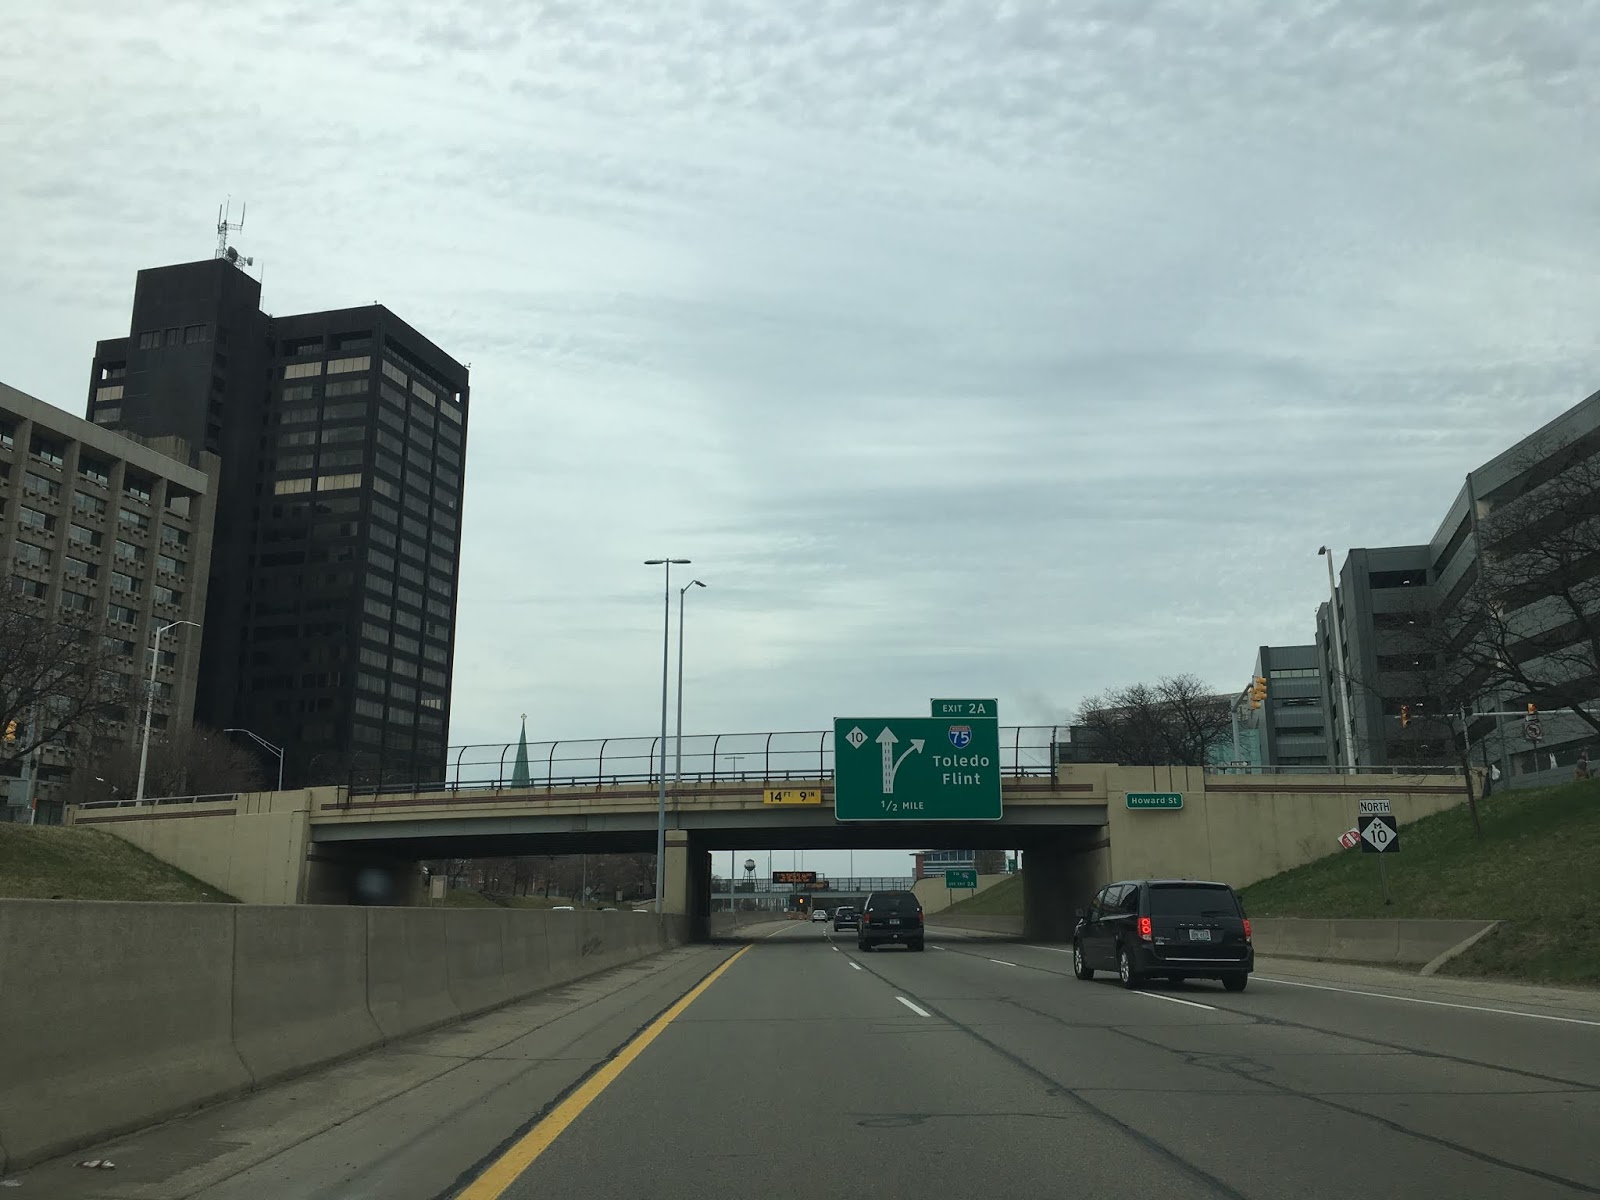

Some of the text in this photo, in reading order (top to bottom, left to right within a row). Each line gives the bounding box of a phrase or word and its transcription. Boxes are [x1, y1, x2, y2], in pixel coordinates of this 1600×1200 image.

[942, 703, 986, 714] EXIT 2A
[850, 732, 864, 743] 10
[950, 731, 970, 744] 75
[932, 754, 990, 767] Toledo
[942, 772, 981, 785] Flint
[880, 800, 925, 812] 1/2 MILE
[1360, 801, 1390, 812] NORTH
[1370, 829, 1388, 843] 10
